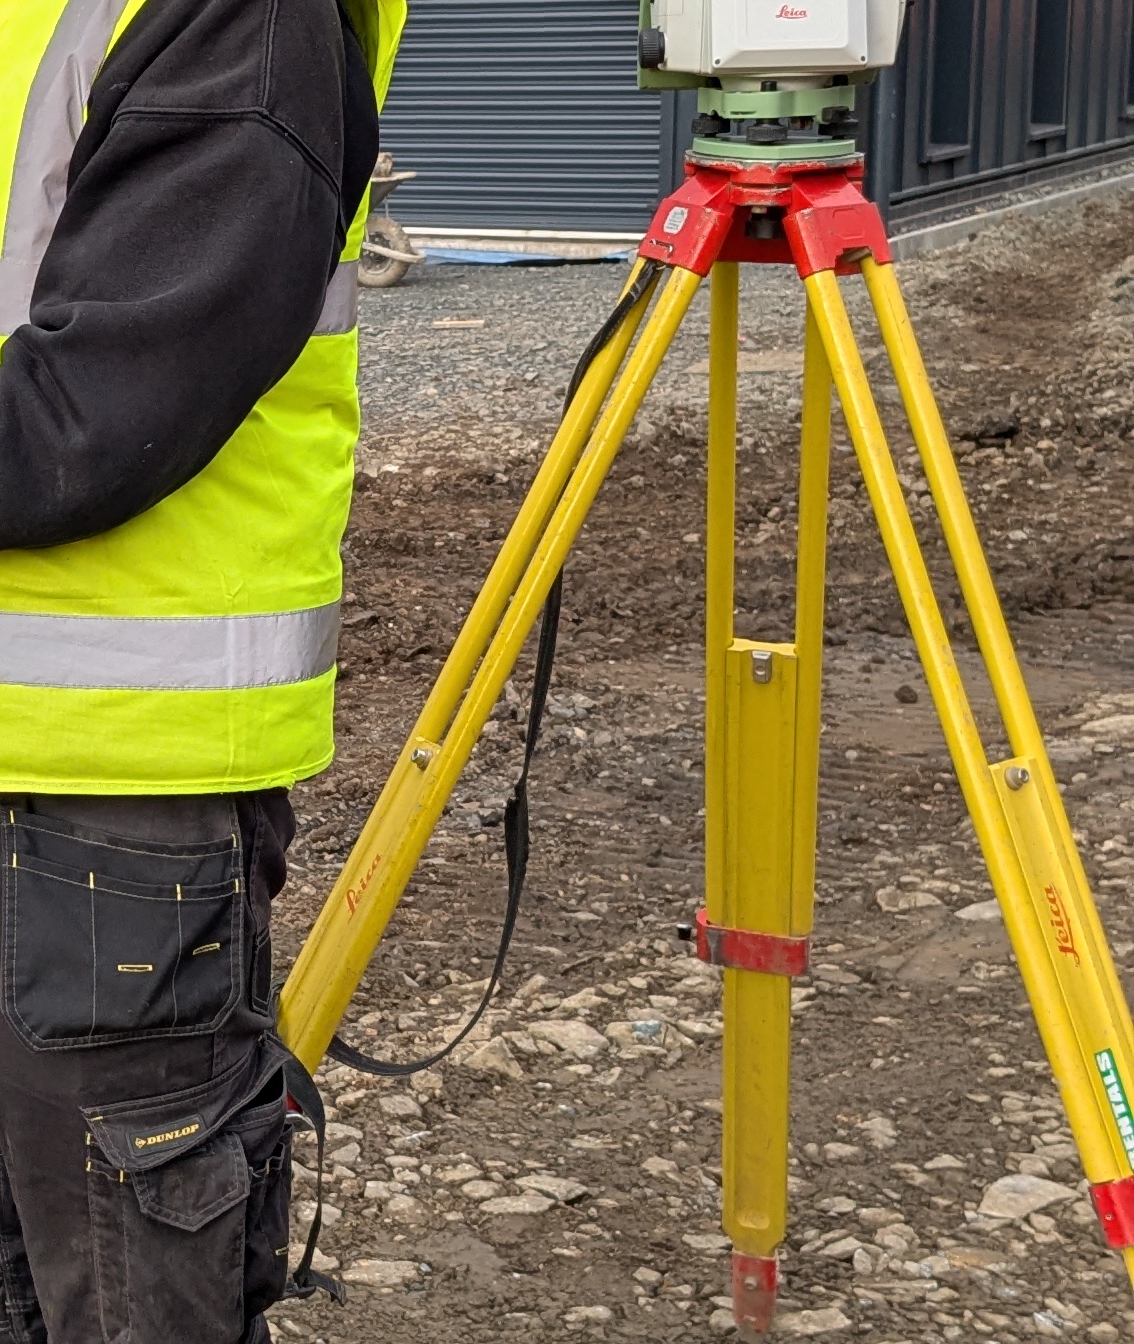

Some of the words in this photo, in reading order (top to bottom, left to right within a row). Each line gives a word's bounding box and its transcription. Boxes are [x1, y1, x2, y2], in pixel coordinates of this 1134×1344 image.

[775, 4, 808, 20] Leica
[1044, 883, 1081, 968] Leica
[147, 1123, 200, 1146] DUNLOP
